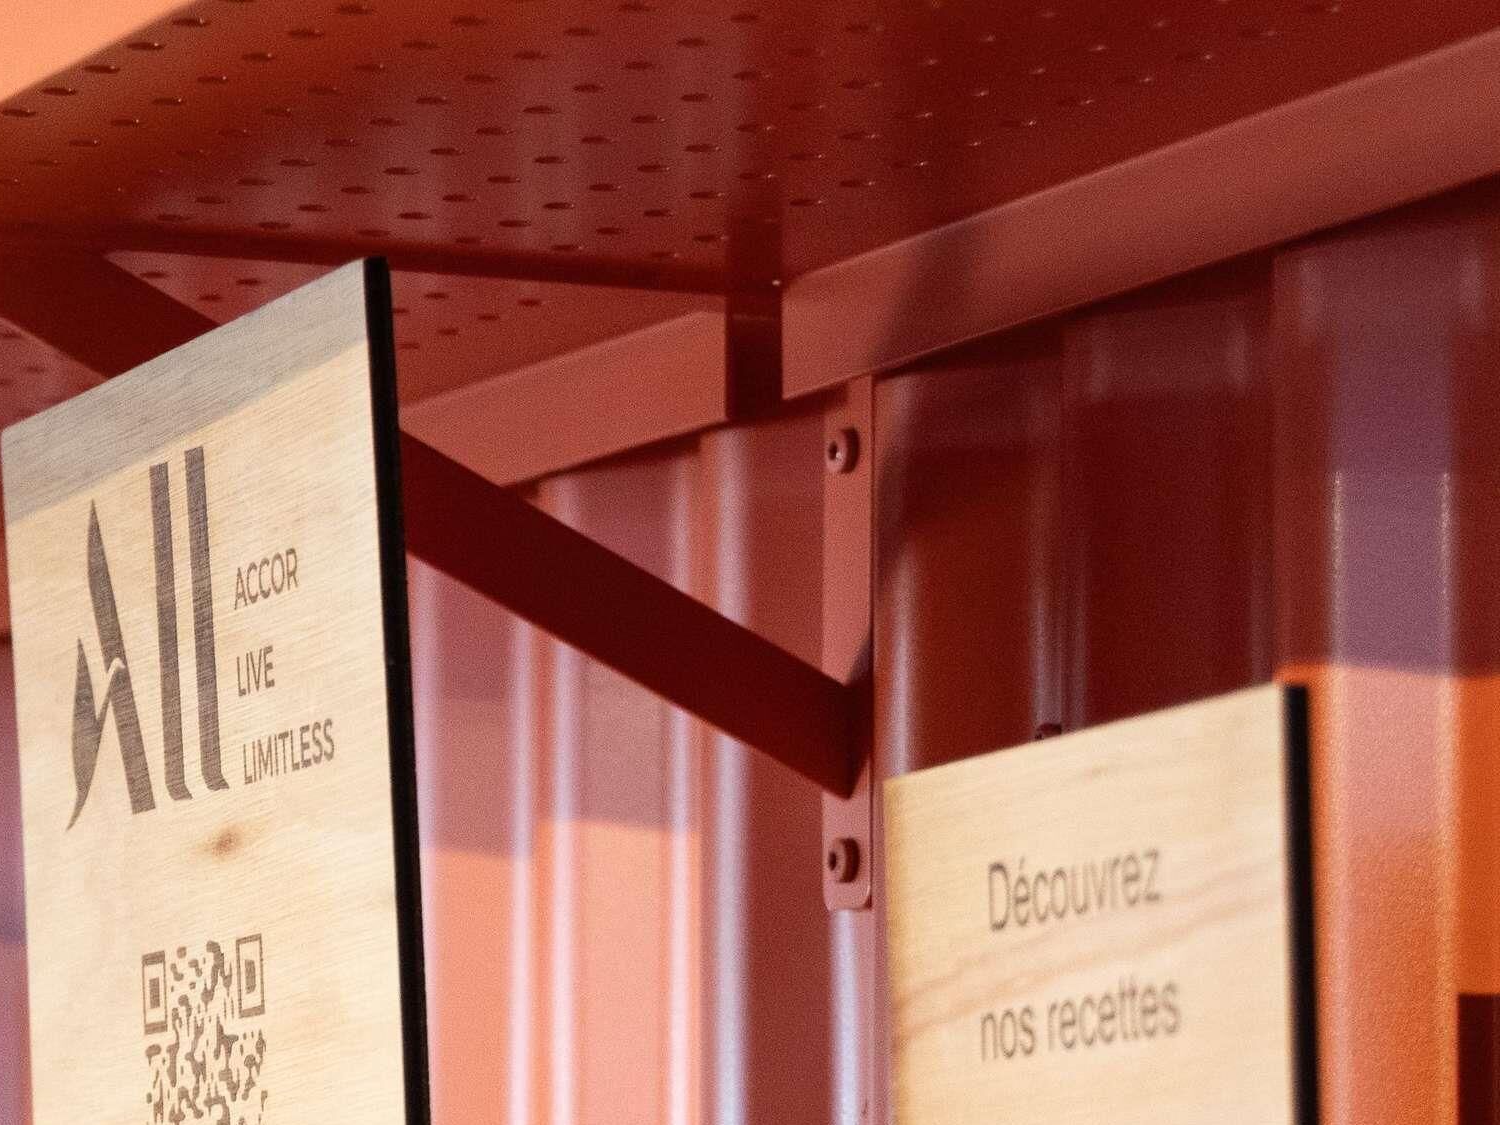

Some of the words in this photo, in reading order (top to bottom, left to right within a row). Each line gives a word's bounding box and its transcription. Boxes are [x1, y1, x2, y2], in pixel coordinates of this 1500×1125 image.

[233, 547, 299, 611] ACCOR
[236, 645, 276, 697] LIVE
[242, 718, 335, 785] LIMITLESS
[987, 847, 1161, 933] Découvrez
[980, 1003, 1037, 1063] nos
[1047, 974, 1182, 1052] recettes
